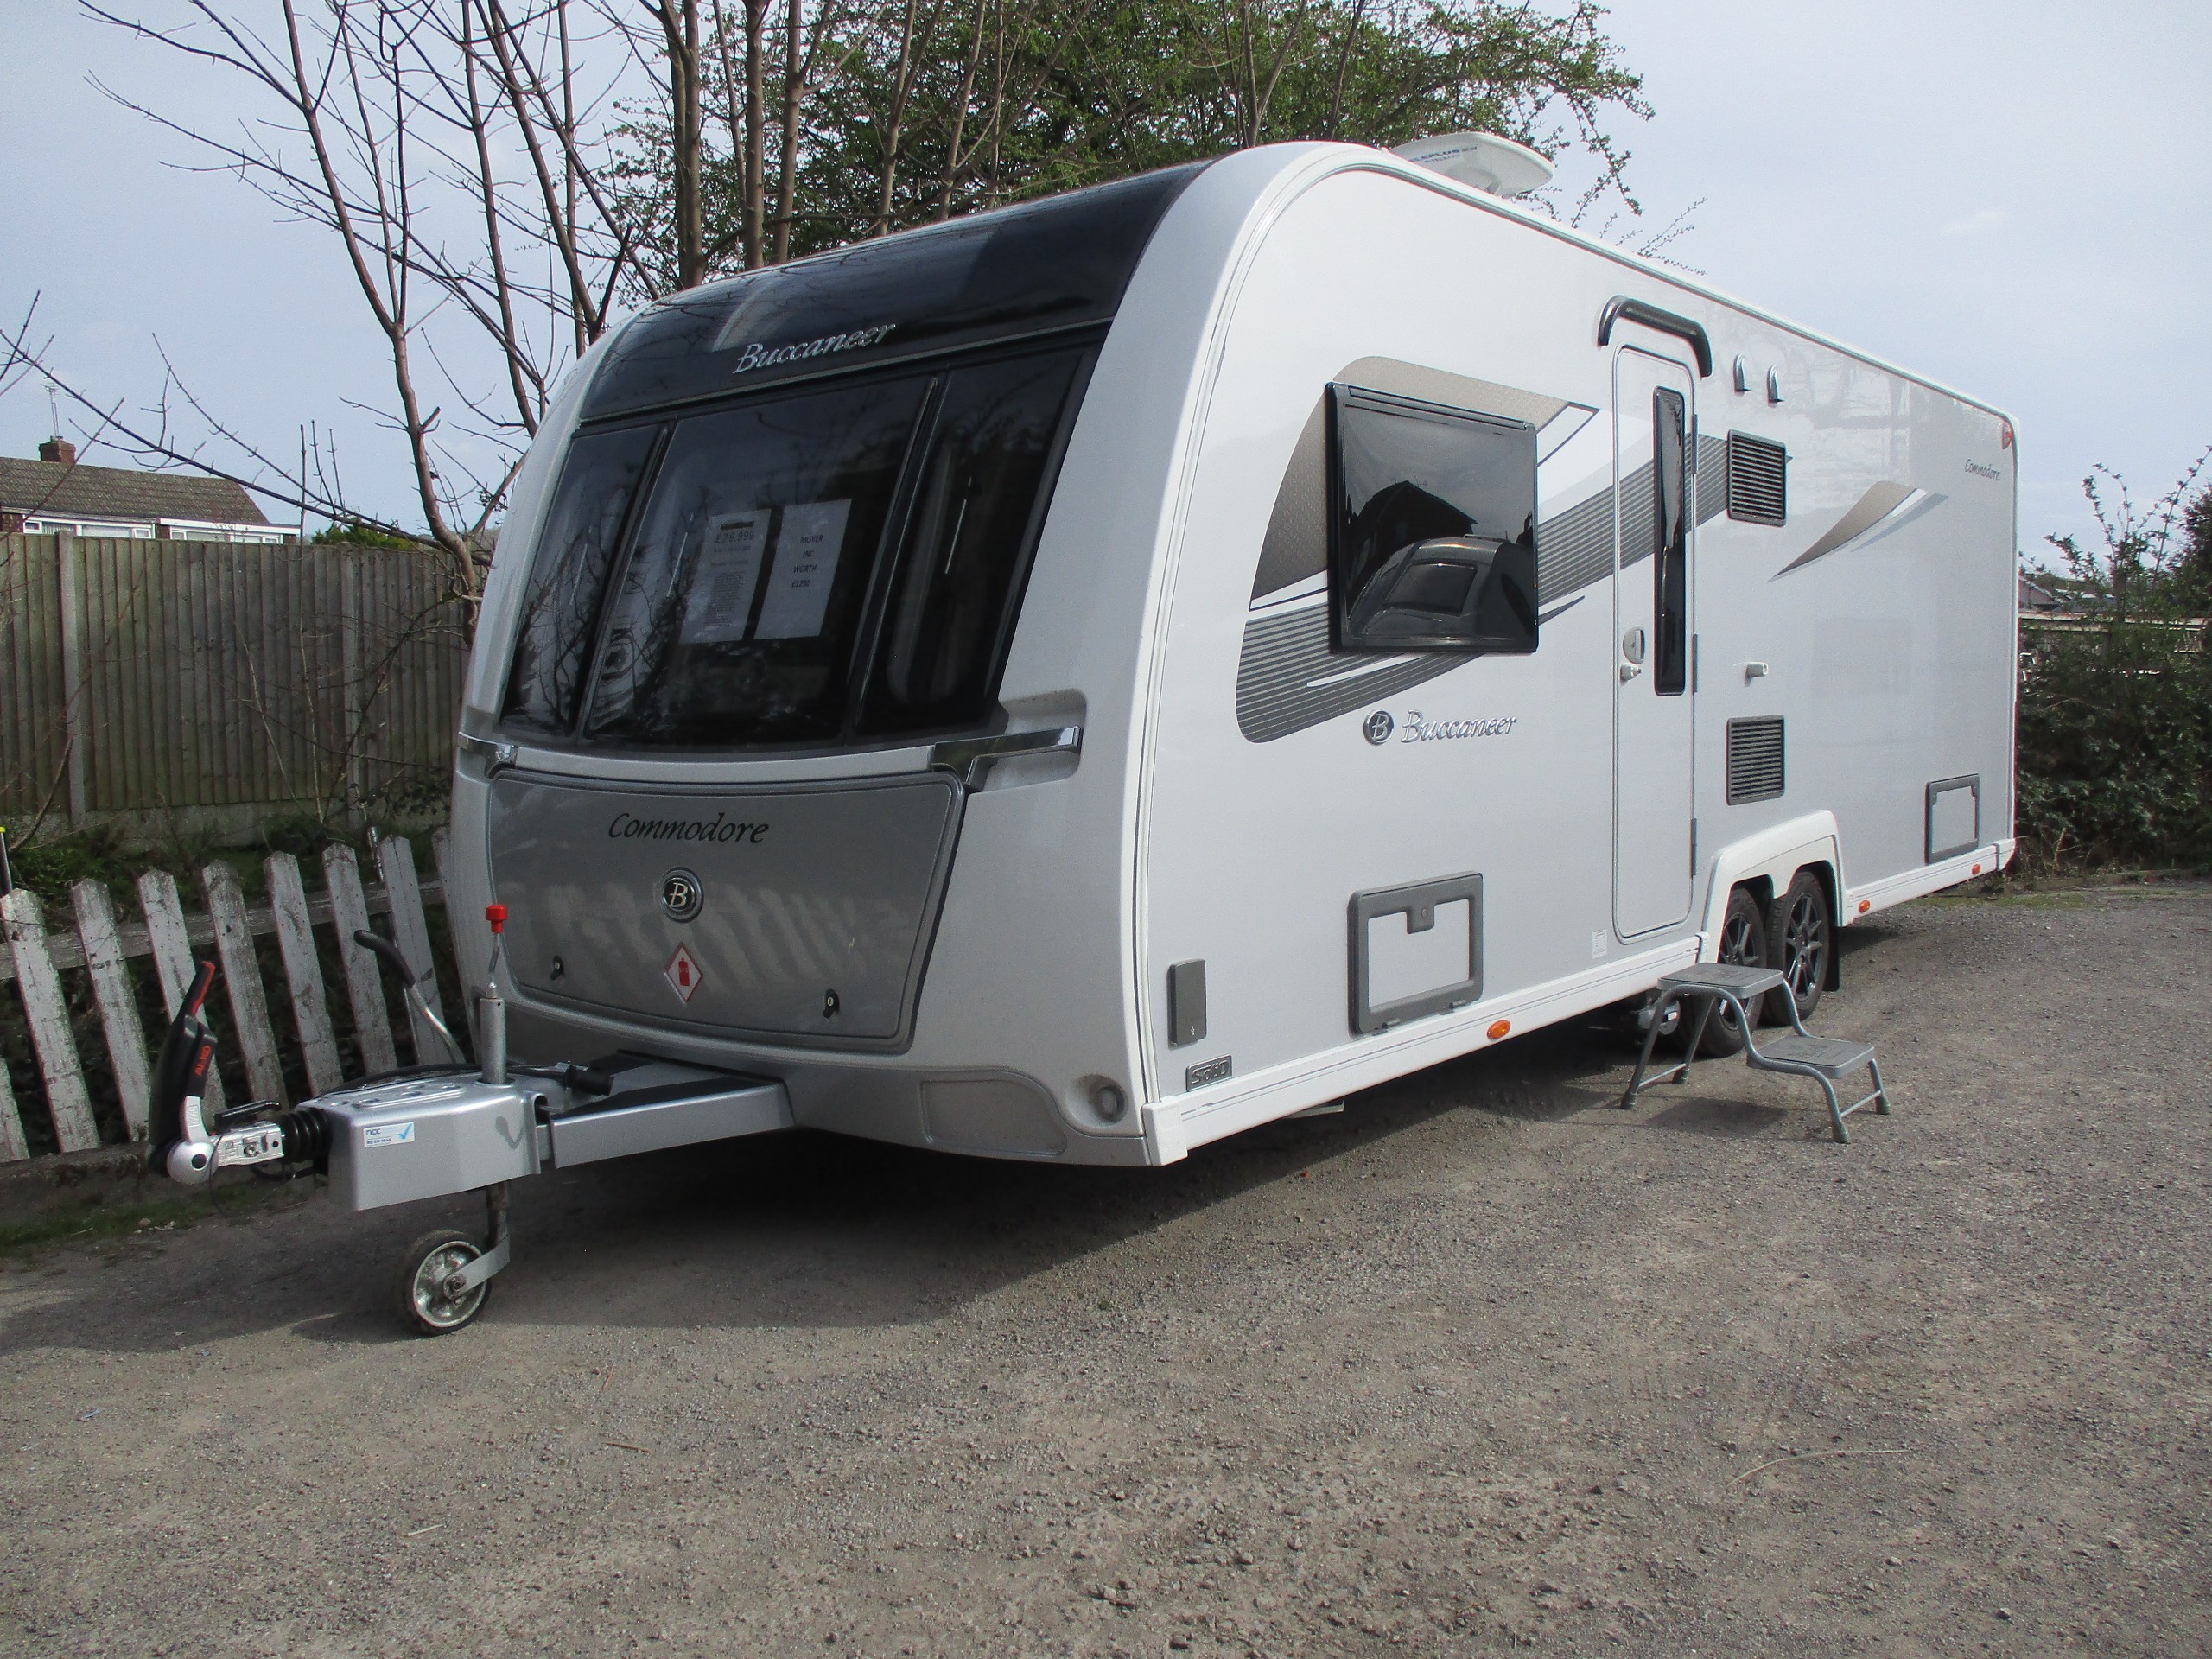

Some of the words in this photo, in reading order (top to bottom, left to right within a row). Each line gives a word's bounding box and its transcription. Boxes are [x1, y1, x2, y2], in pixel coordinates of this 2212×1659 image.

[732, 322, 896, 374] Buccaneer
[1964, 458, 2001, 481] Commodore
[793, 563, 817, 573] WORTH
[1400, 709, 1517, 743] Buccaneer
[607, 811, 770, 844] Commodore
